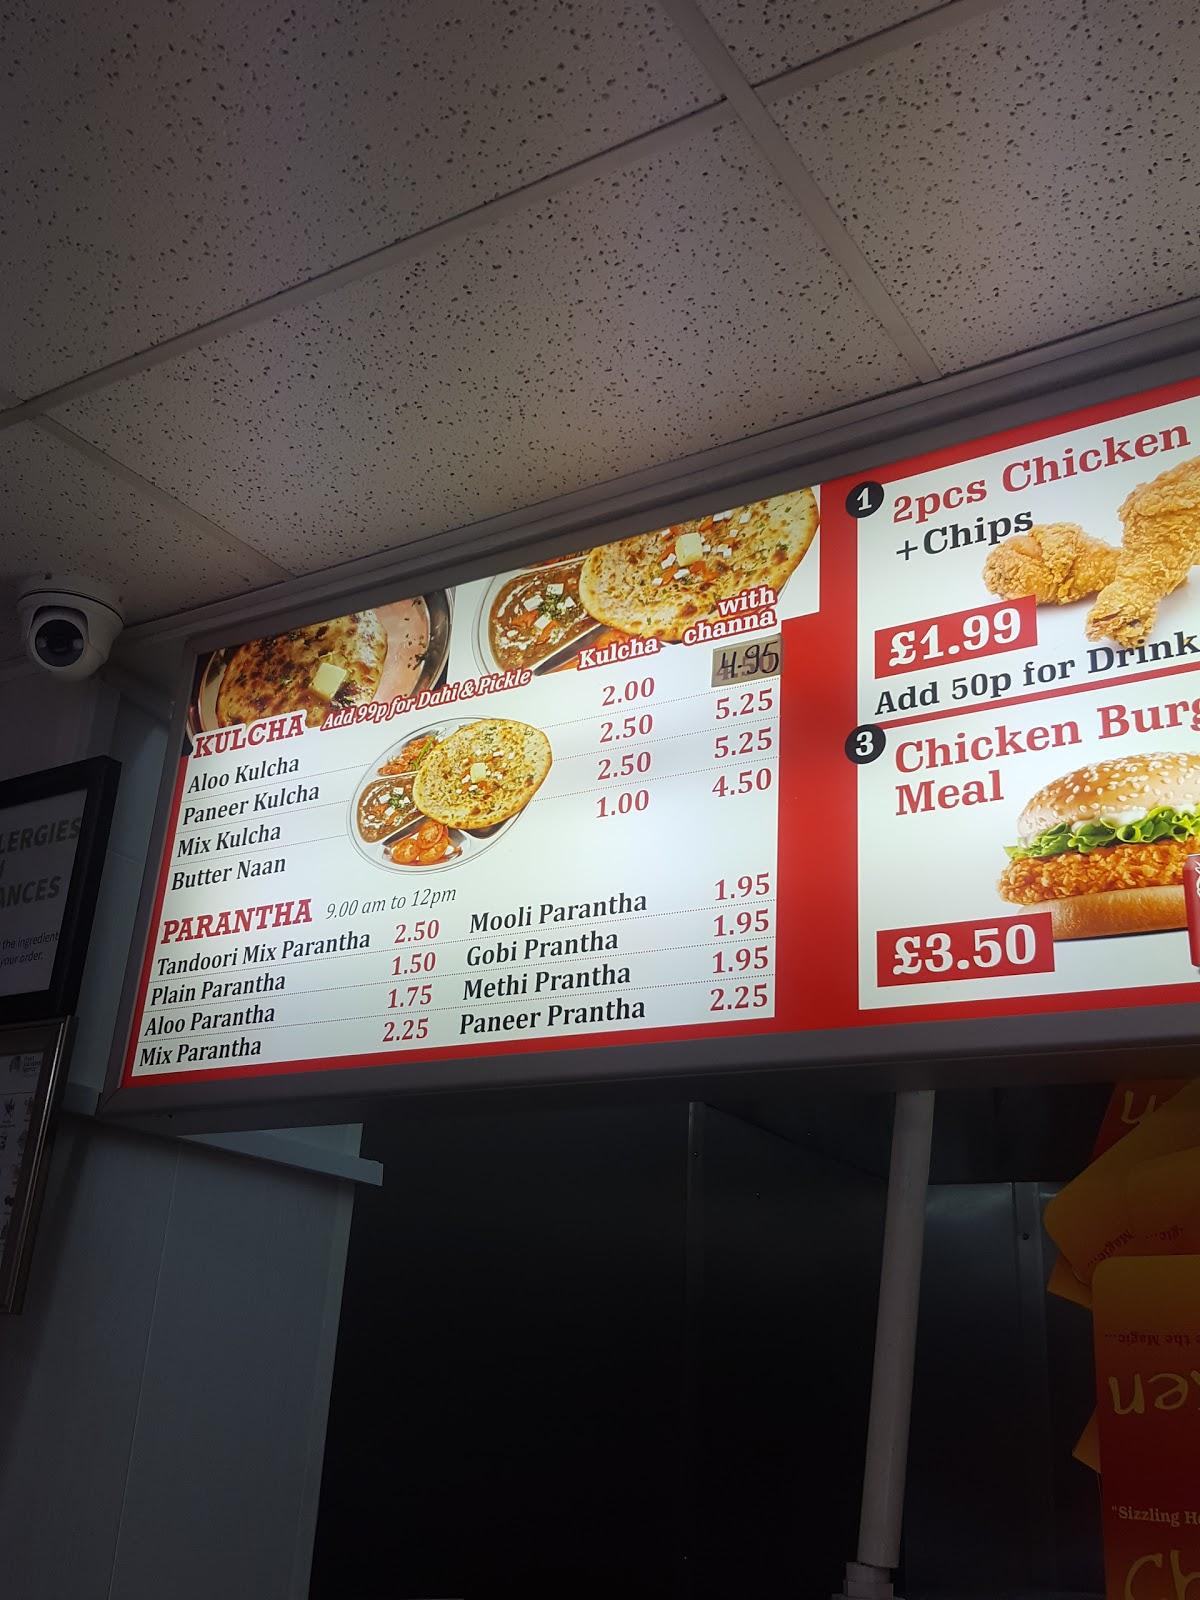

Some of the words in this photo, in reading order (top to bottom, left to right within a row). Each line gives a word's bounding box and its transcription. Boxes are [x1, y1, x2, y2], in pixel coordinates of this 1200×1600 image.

[893, 479, 987, 523] 2pcs
[1002, 424, 1191, 493] Chicken
[857, 487, 872, 511] 1
[719, 586, 776, 616] with
[578, 638, 659, 669] Kulcha
[683, 609, 776, 645] channa
[889, 607, 1021, 667] £1.99
[322, 710, 353, 731] Add
[357, 704, 387, 725] 99p
[386, 697, 416, 721] for
[416, 685, 457, 709] Dahi
[461, 681, 477, 698] &
[477, 670, 532, 694] Pickle
[601, 677, 655, 706] 2.00
[875, 682, 939, 714] Add
[952, 671, 1012, 703] 50p
[1023, 657, 1075, 686] for
[715, 688, 773, 720] 5.25
[193, 714, 305, 759] KULCHA
[599, 714, 653, 743] 2.50
[714, 727, 773, 759] 5.25
[855, 731, 874, 757] 3
[895, 718, 1081, 773] Chicken
[187, 771, 229, 794] Aloo
[234, 758, 299, 785] Kulcha
[597, 751, 651, 780] 2.50
[712, 768, 772, 798] 4.50
[895, 769, 1004, 816] Meal
[182, 801, 249, 826] Paneer
[253, 783, 320, 813] Kulcha
[595, 789, 650, 818] 1.00
[177, 837, 210, 858] Mix
[215, 823, 281, 851] Kulcha
[172, 866, 232, 891] Butter
[236, 858, 286, 880] Naan
[714, 873, 770, 902] 1.95
[161, 898, 313, 945] PARANTHA
[326, 899, 359, 920] 9.00
[361, 898, 386, 914] am
[390, 893, 406, 910] to
[411, 888, 457, 911] 12pm
[470, 906, 532, 934] Mooli
[539, 892, 648, 923] Parantha
[713, 908, 769, 938] 1.95
[394, 919, 440, 944] 2.50
[466, 940, 517, 966] Gobi
[524, 930, 619, 960] Prantha
[157, 945, 237, 976] Tandoori
[242, 944, 276, 965] Mix
[281, 931, 371, 960] Parantha
[391, 951, 437, 976] 1.50
[712, 945, 769, 974] 1.95
[892, 924, 1036, 976] £3.50
[151, 981, 196, 1006] Plain
[201, 972, 286, 1000] Parantha
[387, 984, 433, 1010] 1.75
[462, 973, 528, 1001] Methi
[535, 963, 631, 993] Prantha
[709, 983, 768, 1012] 2.25
[144, 1014, 186, 1037] Aloo
[190, 1004, 276, 1031] Parantha
[382, 1017, 429, 1042] 2.25
[459, 1008, 541, 1035] Paneer
[547, 998, 646, 1027] Prantha
[139, 1046, 172, 1067] Mix
[176, 1037, 262, 1063] Parantha
